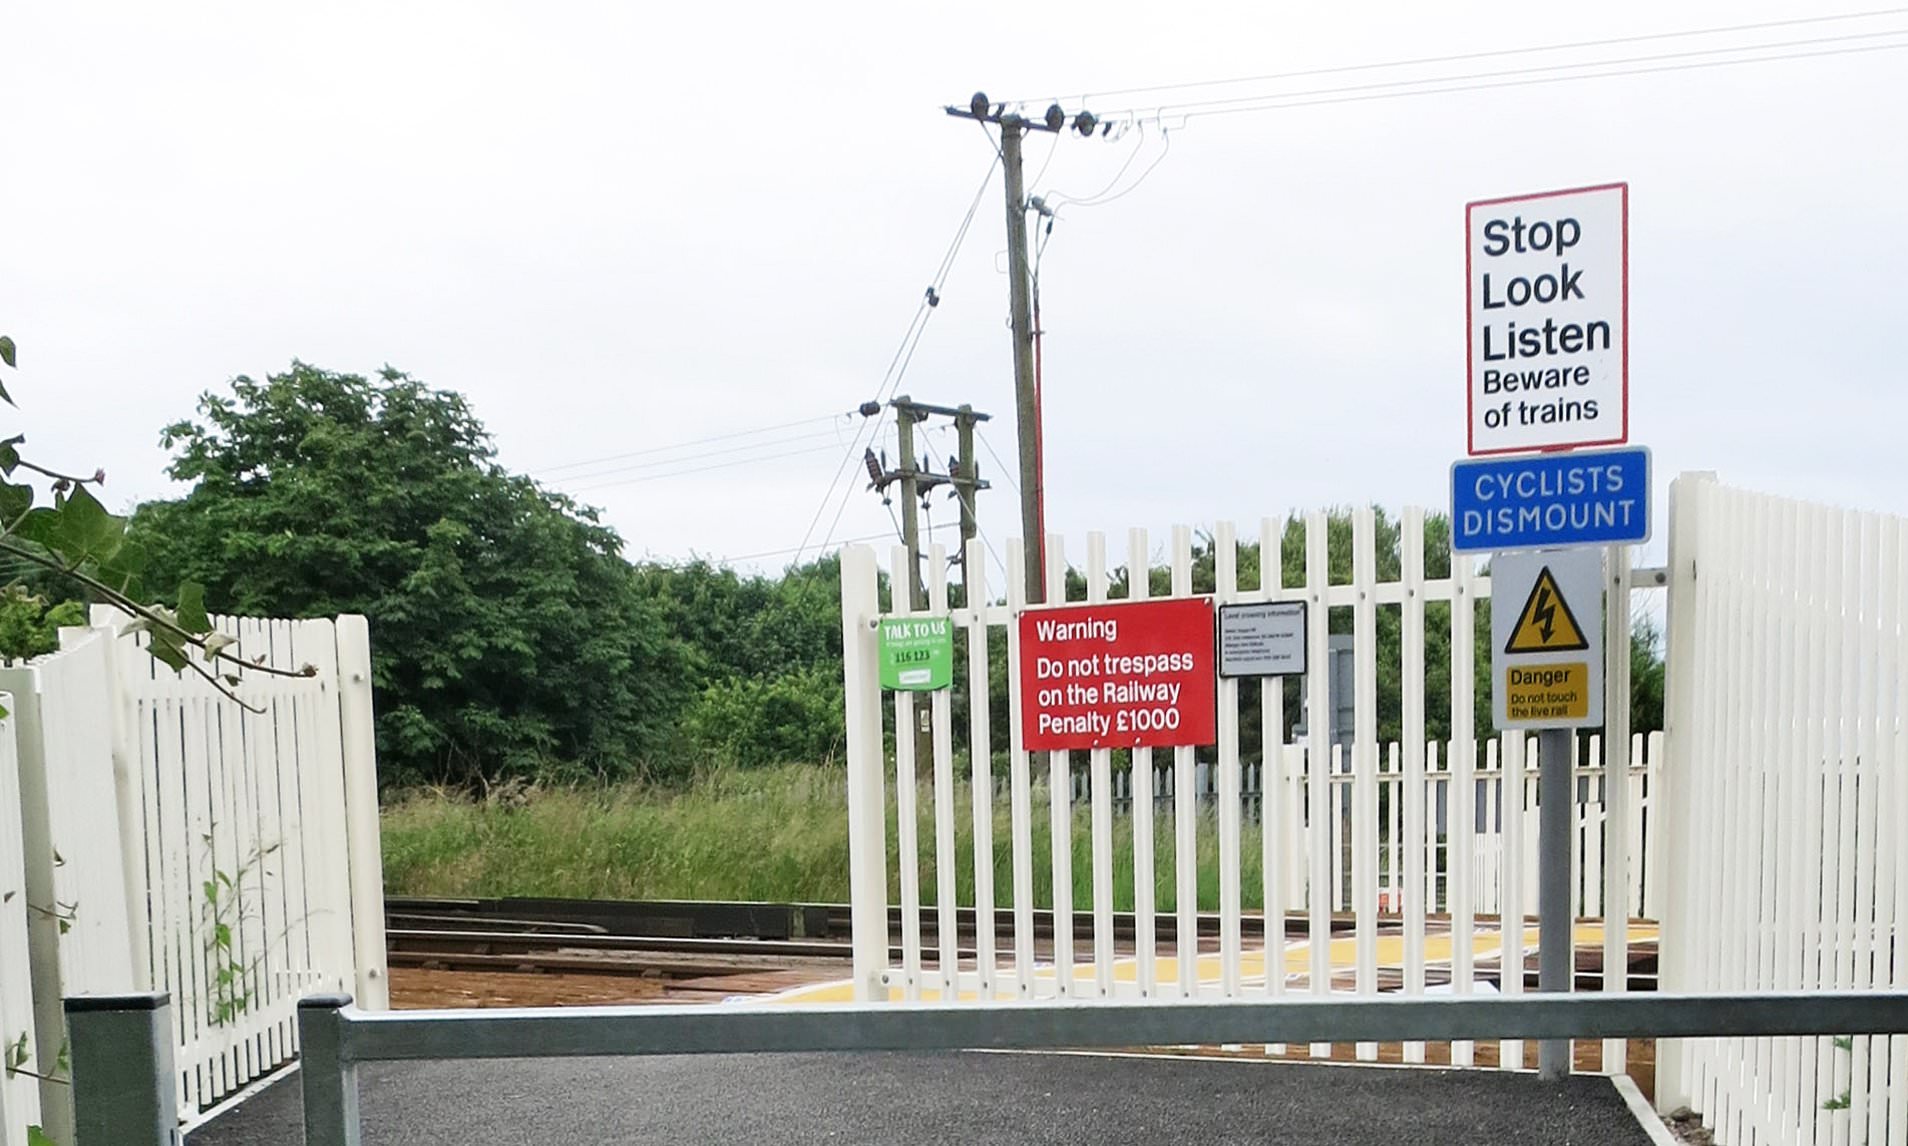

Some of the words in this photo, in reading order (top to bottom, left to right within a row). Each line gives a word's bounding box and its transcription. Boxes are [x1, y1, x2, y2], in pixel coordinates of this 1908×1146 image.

[1483, 216, 1581, 257] Stop
[1483, 263, 1585, 309] Look
[1483, 318, 1610, 361] Listen
[1483, 365, 1590, 395] Beware
[1484, 401, 1511, 428] of
[1518, 397, 1599, 425] trains
[1475, 465, 1623, 501] CYCLISTS
[1464, 499, 1635, 536] DISMOUNT
[884, 622, 911, 641] TALK
[913, 623, 929, 638] TO
[930, 620, 946, 635] US
[1036, 617, 1117, 642] Warning
[896, 651, 911, 663] 116
[914, 649, 930, 662] 123
[1037, 657, 1063, 679] Do
[1068, 654, 1100, 677] not
[1104, 652, 1194, 677] trespass
[1511, 669, 1572, 687] Danger
[1038, 688, 1062, 707] on
[1067, 683, 1098, 705] the
[1103, 681, 1181, 705] Railway
[1511, 694, 1525, 704] Do
[1527, 693, 1545, 703] not
[1547, 691, 1577, 703] touch
[1039, 711, 1110, 736] Penalty
[1116, 708, 1180, 732] £1000
[1512, 707, 1528, 718] the
[1531, 705, 1549, 717] live
[1551, 704, 1568, 716] rail
